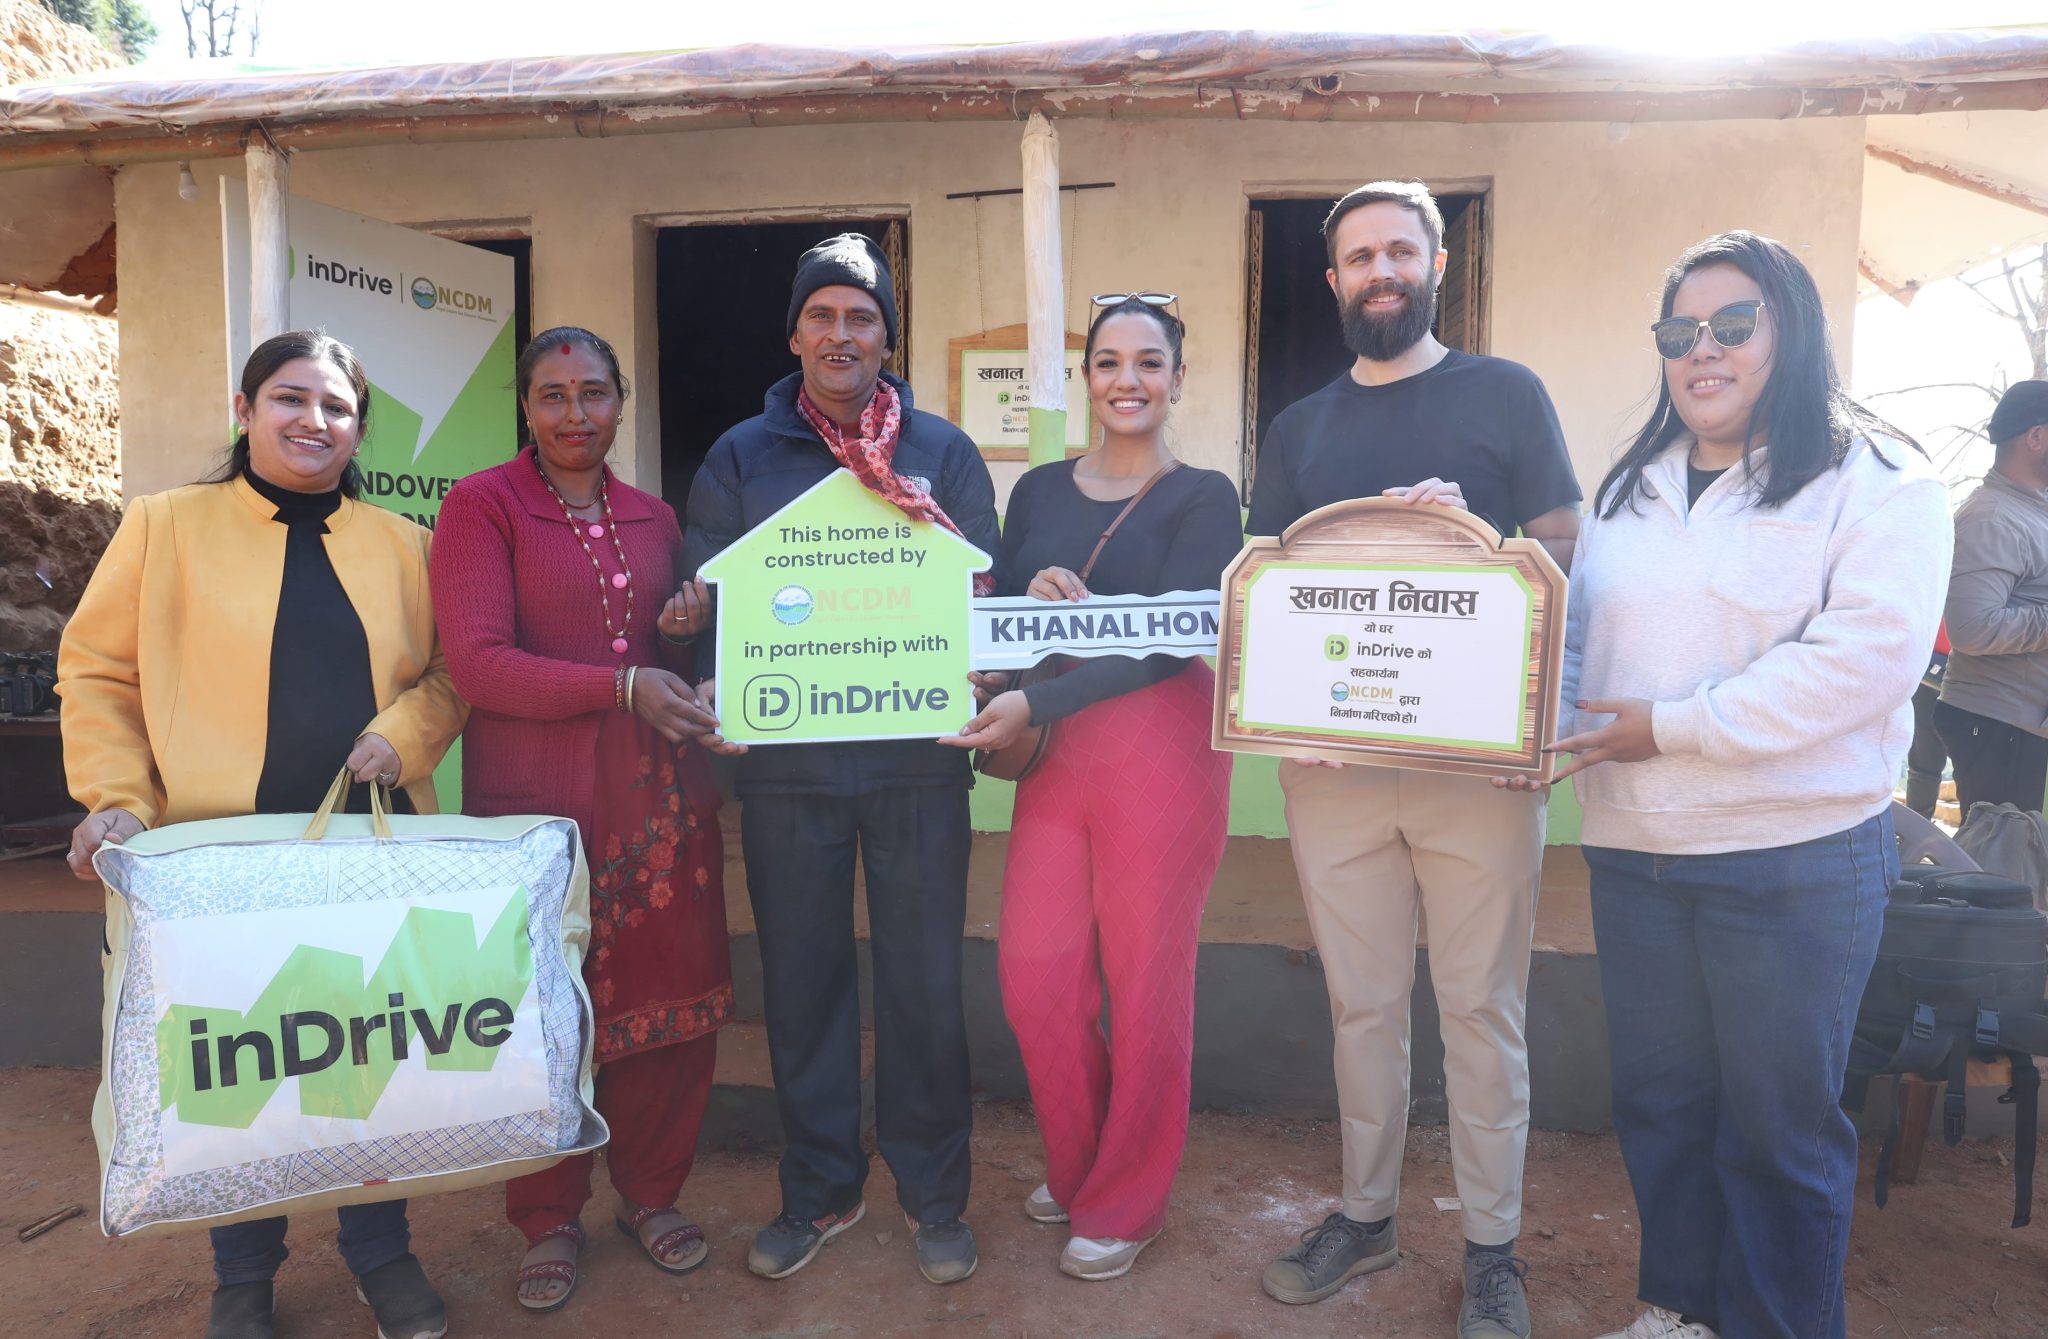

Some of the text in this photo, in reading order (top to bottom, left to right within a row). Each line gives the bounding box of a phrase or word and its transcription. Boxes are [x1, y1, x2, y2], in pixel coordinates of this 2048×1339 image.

[308, 254, 393, 295] inDrive
[438, 286, 492, 315] NCDM
[978, 367, 1024, 380] खनाल
[1014, 393, 1029, 402] inD
[360, 471, 459, 500] NDOVE
[779, 522, 911, 544] This home is
[765, 547, 927, 569] constructed by
[817, 586, 912, 611] NCDM
[1290, 580, 1479, 616] खनाल निवास
[991, 613, 1139, 643] KHANAL
[1364, 622, 1394, 634] यो घर
[744, 635, 948, 662] in partnership with
[1357, 642, 1414, 658] inDrive
[1417, 648, 1432, 659] को
[1350, 667, 1399, 679] सहकार्यमा
[810, 681, 949, 715] inDrive
[1350, 685, 1393, 699] NCDM
[1399, 695, 1421, 706] द्वारा
[1330, 706, 1361, 719] निर्माण
[190, 992, 515, 1092] inDrive
